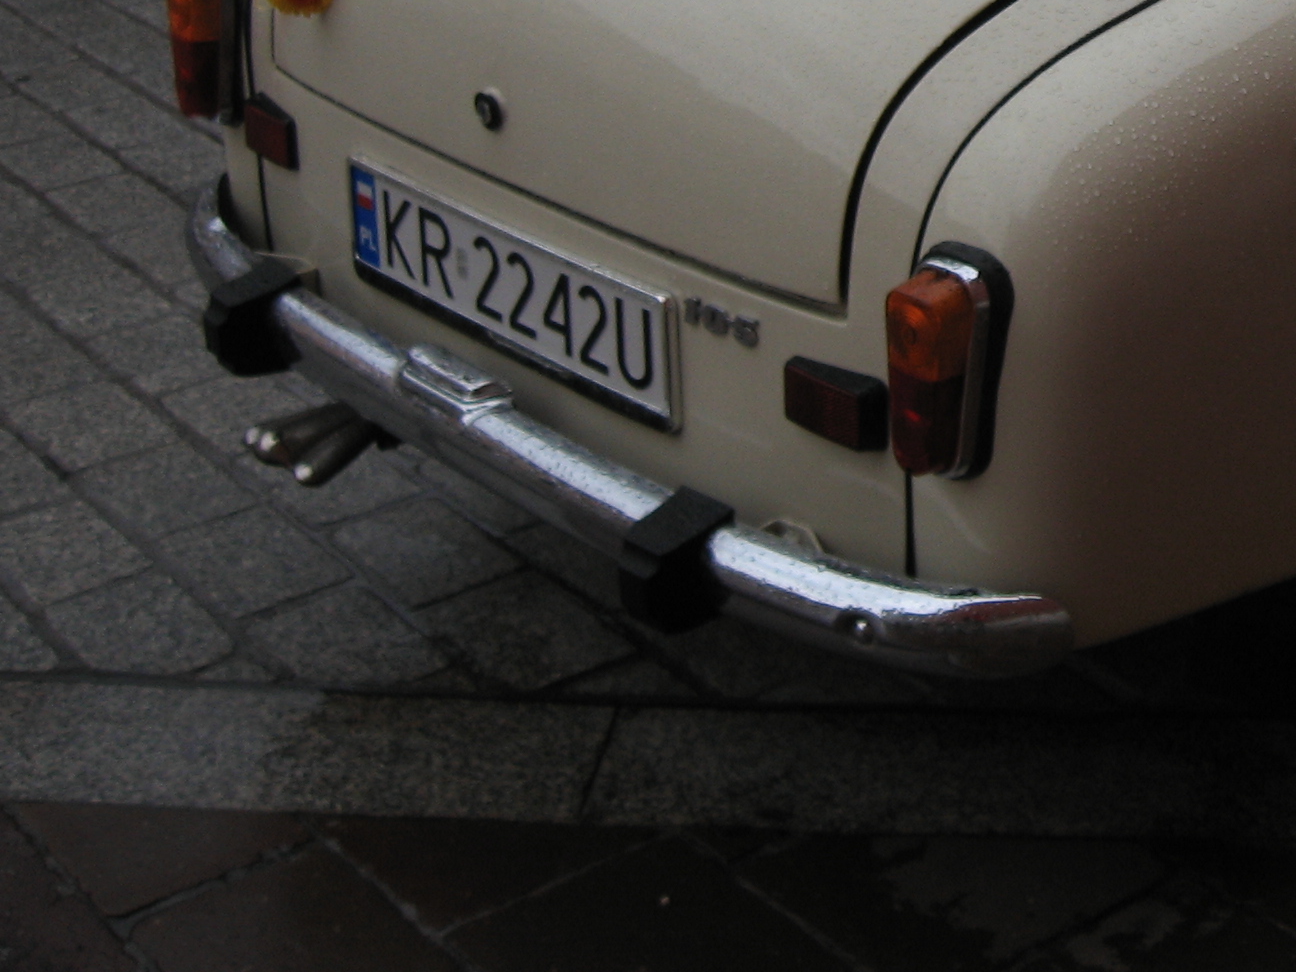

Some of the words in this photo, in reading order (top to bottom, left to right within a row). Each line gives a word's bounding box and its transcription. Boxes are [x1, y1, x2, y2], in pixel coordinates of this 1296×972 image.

[359, 226, 378, 253] PL
[383, 190, 454, 299] KR
[474, 236, 655, 390] 2242U
